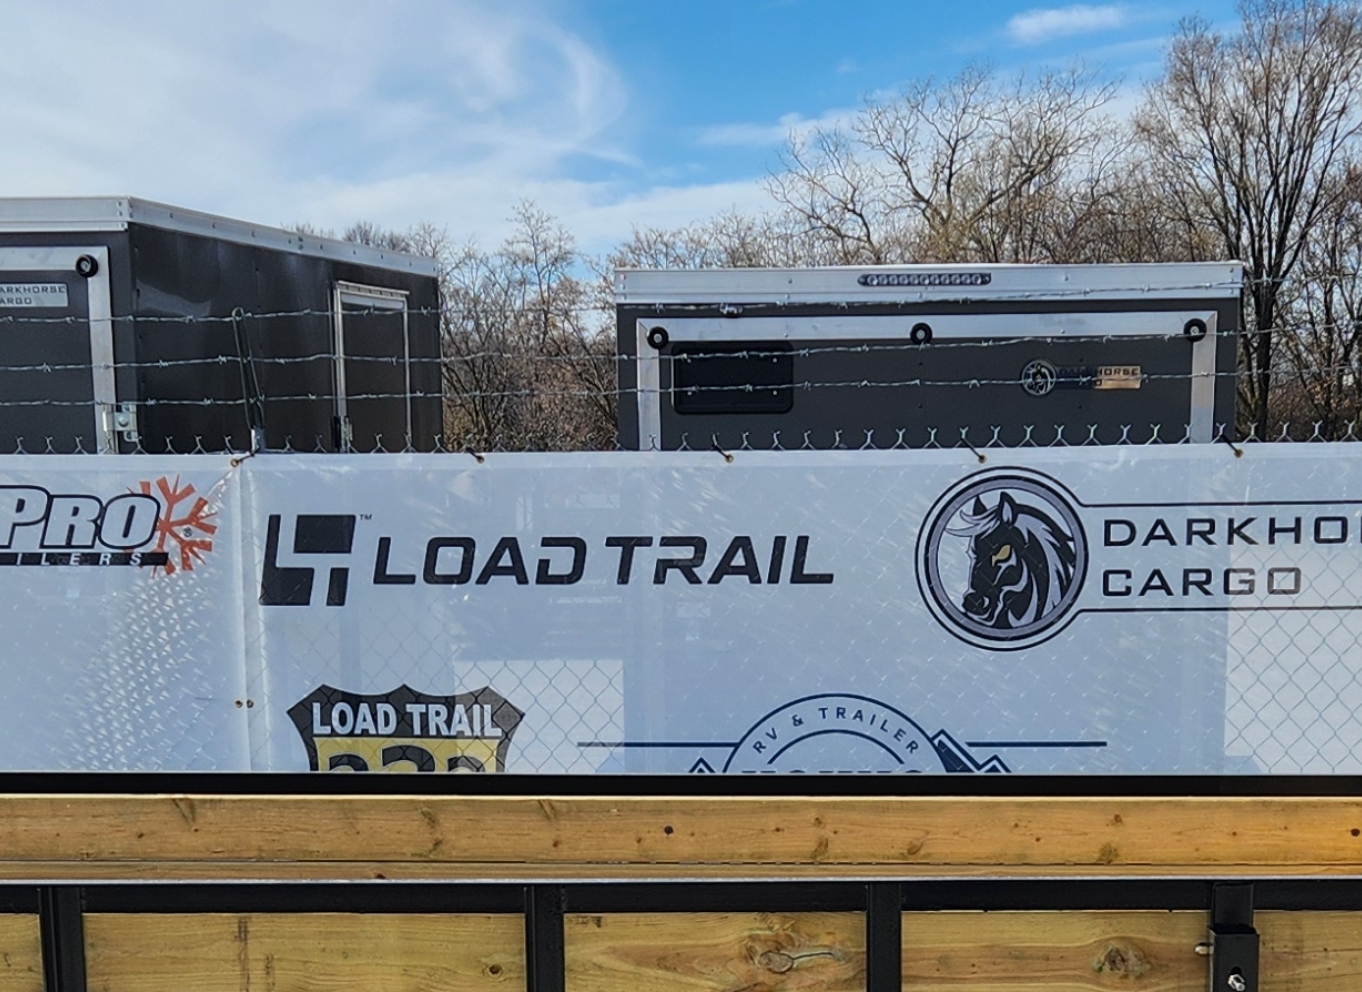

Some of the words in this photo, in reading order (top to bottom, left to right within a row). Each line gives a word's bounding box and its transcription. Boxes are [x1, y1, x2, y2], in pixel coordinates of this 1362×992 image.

[373, 536, 586, 585] LOAD
[604, 535, 834, 585] TRAIL
[1102, 567, 1302, 597] CARGO
[312, 702, 397, 735] LOAD
[405, 703, 503, 737] TRAIL
[752, 727, 778, 754] RV
[792, 714, 804, 727] &
[818, 706, 919, 754] TRAILER
